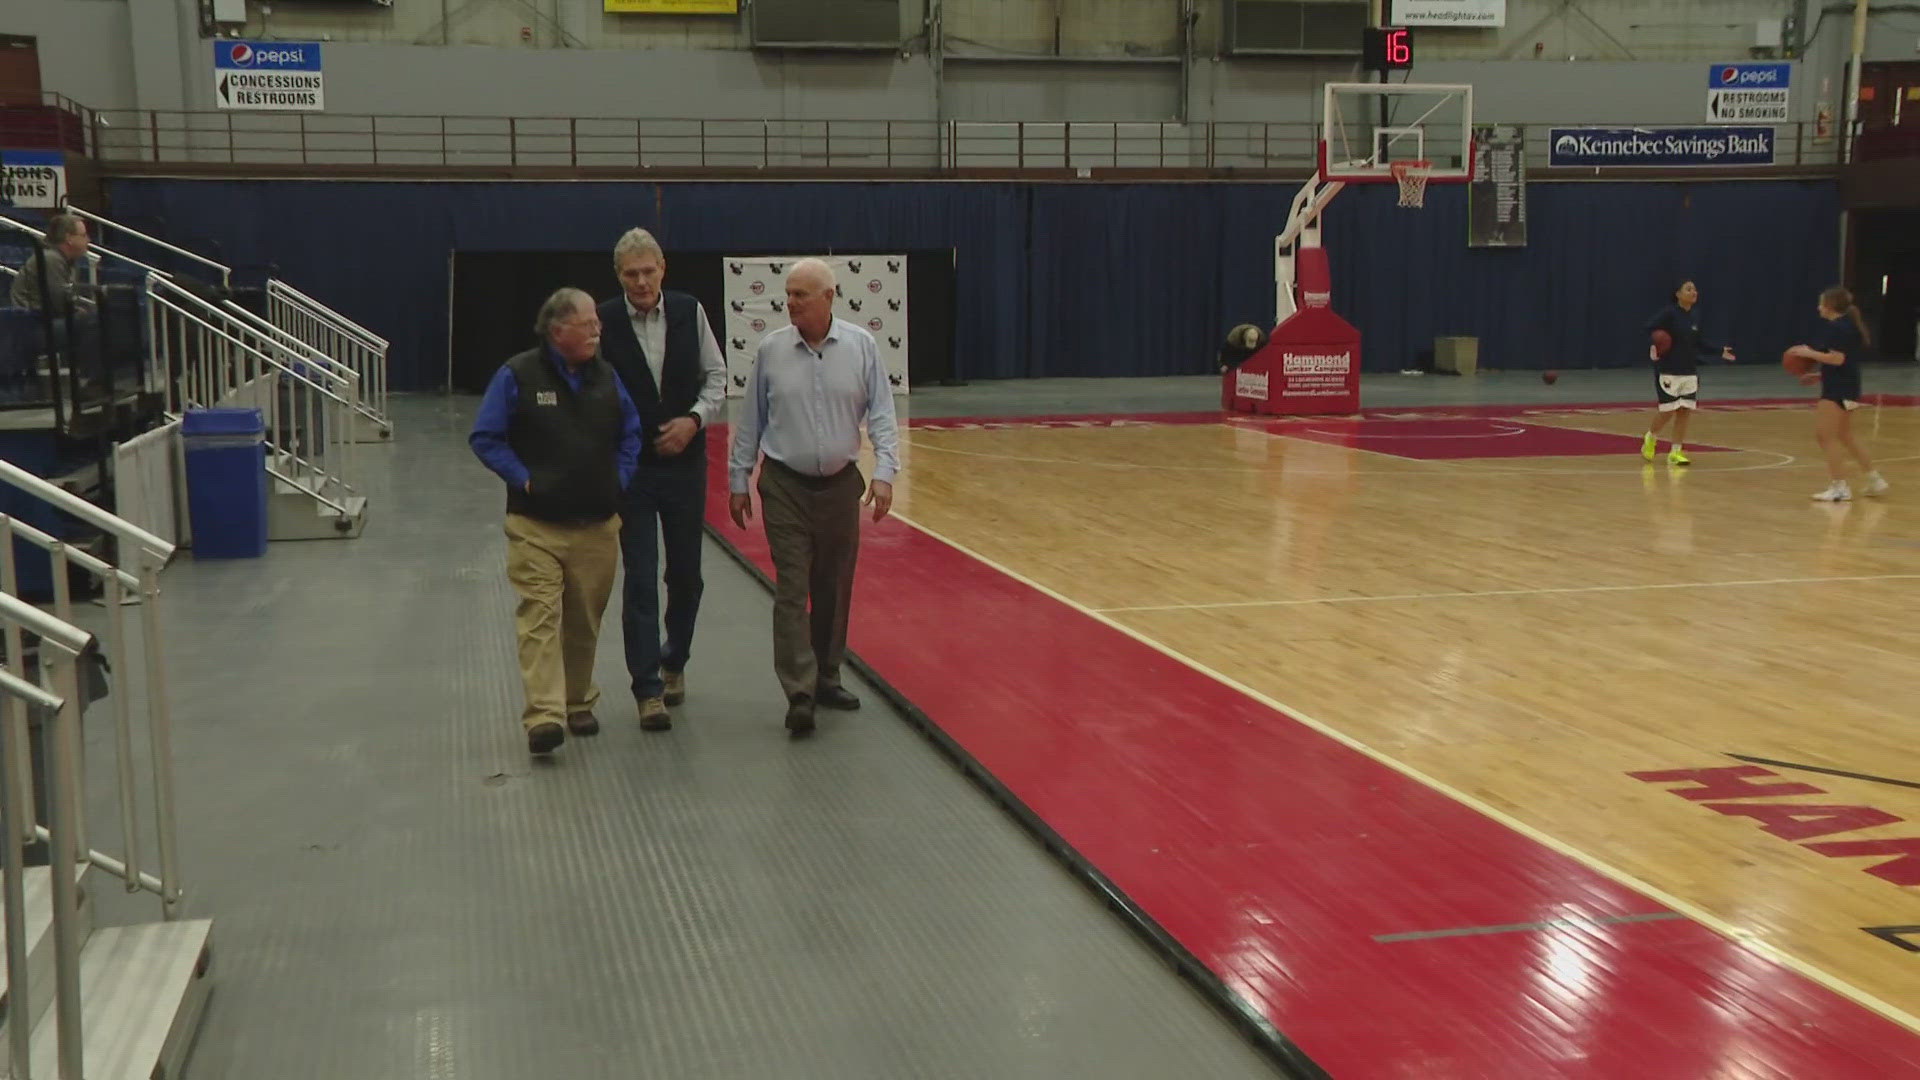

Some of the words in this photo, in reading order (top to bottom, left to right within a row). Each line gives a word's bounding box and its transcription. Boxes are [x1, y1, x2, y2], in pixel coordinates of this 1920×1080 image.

[1386, 31, 1409, 62] 16
[256, 49, 303, 66] pepsi
[230, 74, 321, 89] CONCESSIONS
[1740, 69, 1777, 84] pepsi
[236, 91, 316, 106] RESTROOMS
[1723, 91, 1786, 104] RESTROOMS
[1721, 107, 1735, 119] NO
[1739, 106, 1786, 119] SMOKING
[1578, 136, 1663, 155] Kennebec
[1665, 135, 1726, 160] Savings
[1728, 133, 1769, 154] Bank
[1283, 351, 1350, 366] Hammond
